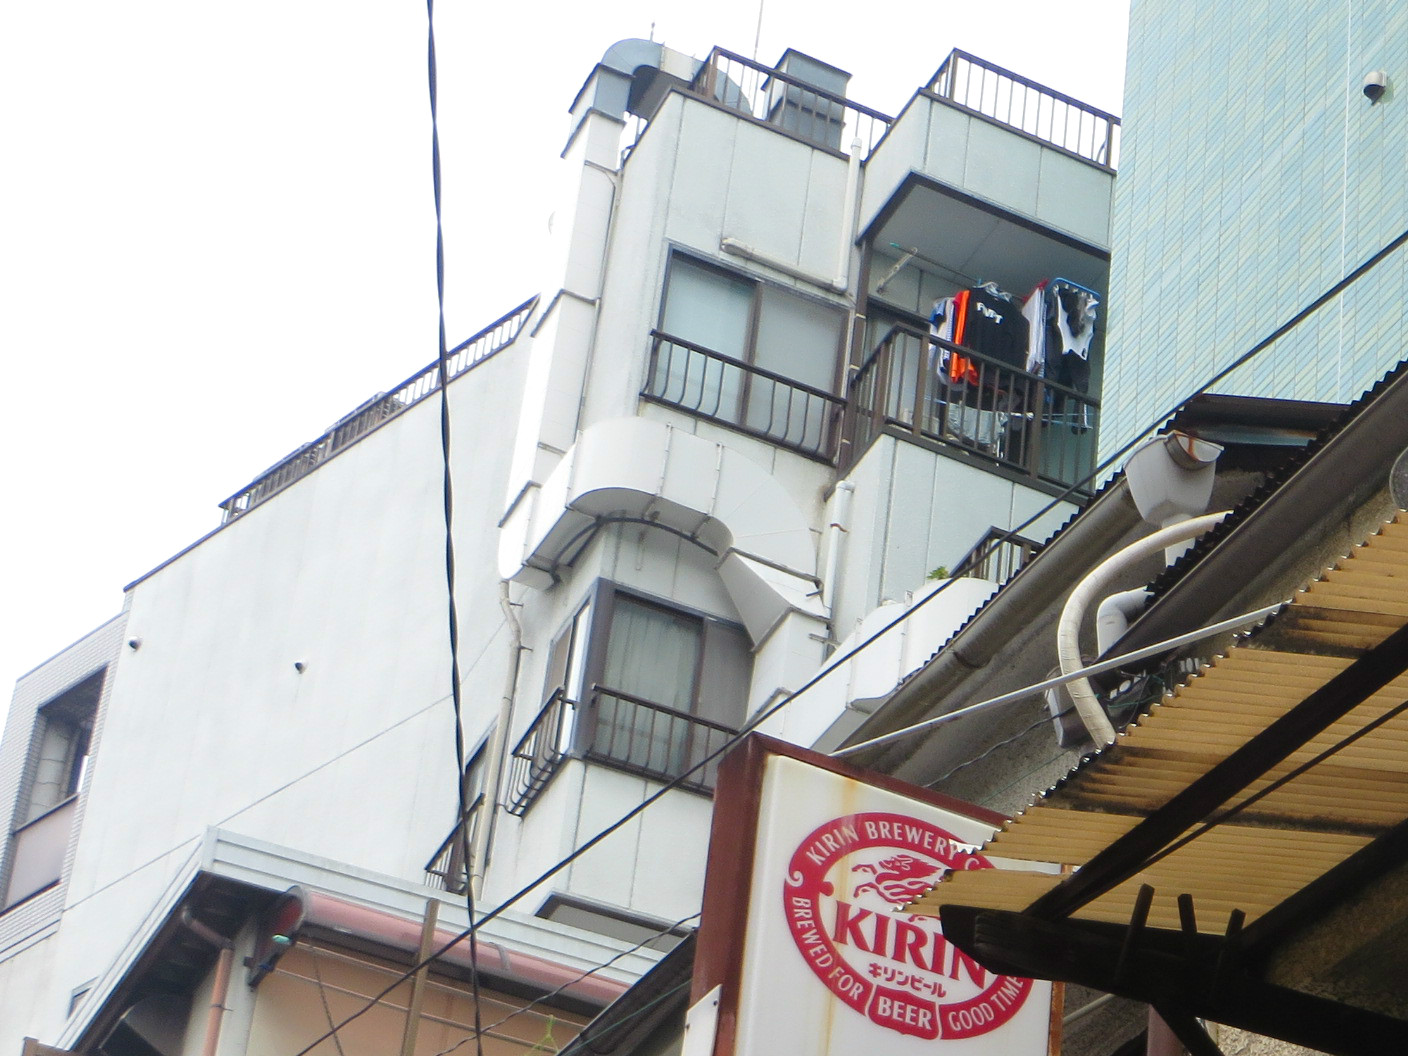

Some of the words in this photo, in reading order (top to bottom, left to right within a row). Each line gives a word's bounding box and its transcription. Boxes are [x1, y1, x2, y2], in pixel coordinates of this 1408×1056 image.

[806, 823, 860, 867] KIRIN
[791, 896, 833, 970] BREWED
[828, 967, 865, 1002] FOR
[868, 962, 947, 999] キリンビール
[877, 997, 933, 1031] BEER
[948, 1003, 996, 1032] GOOD
[990, 976, 1025, 1012] TIME
